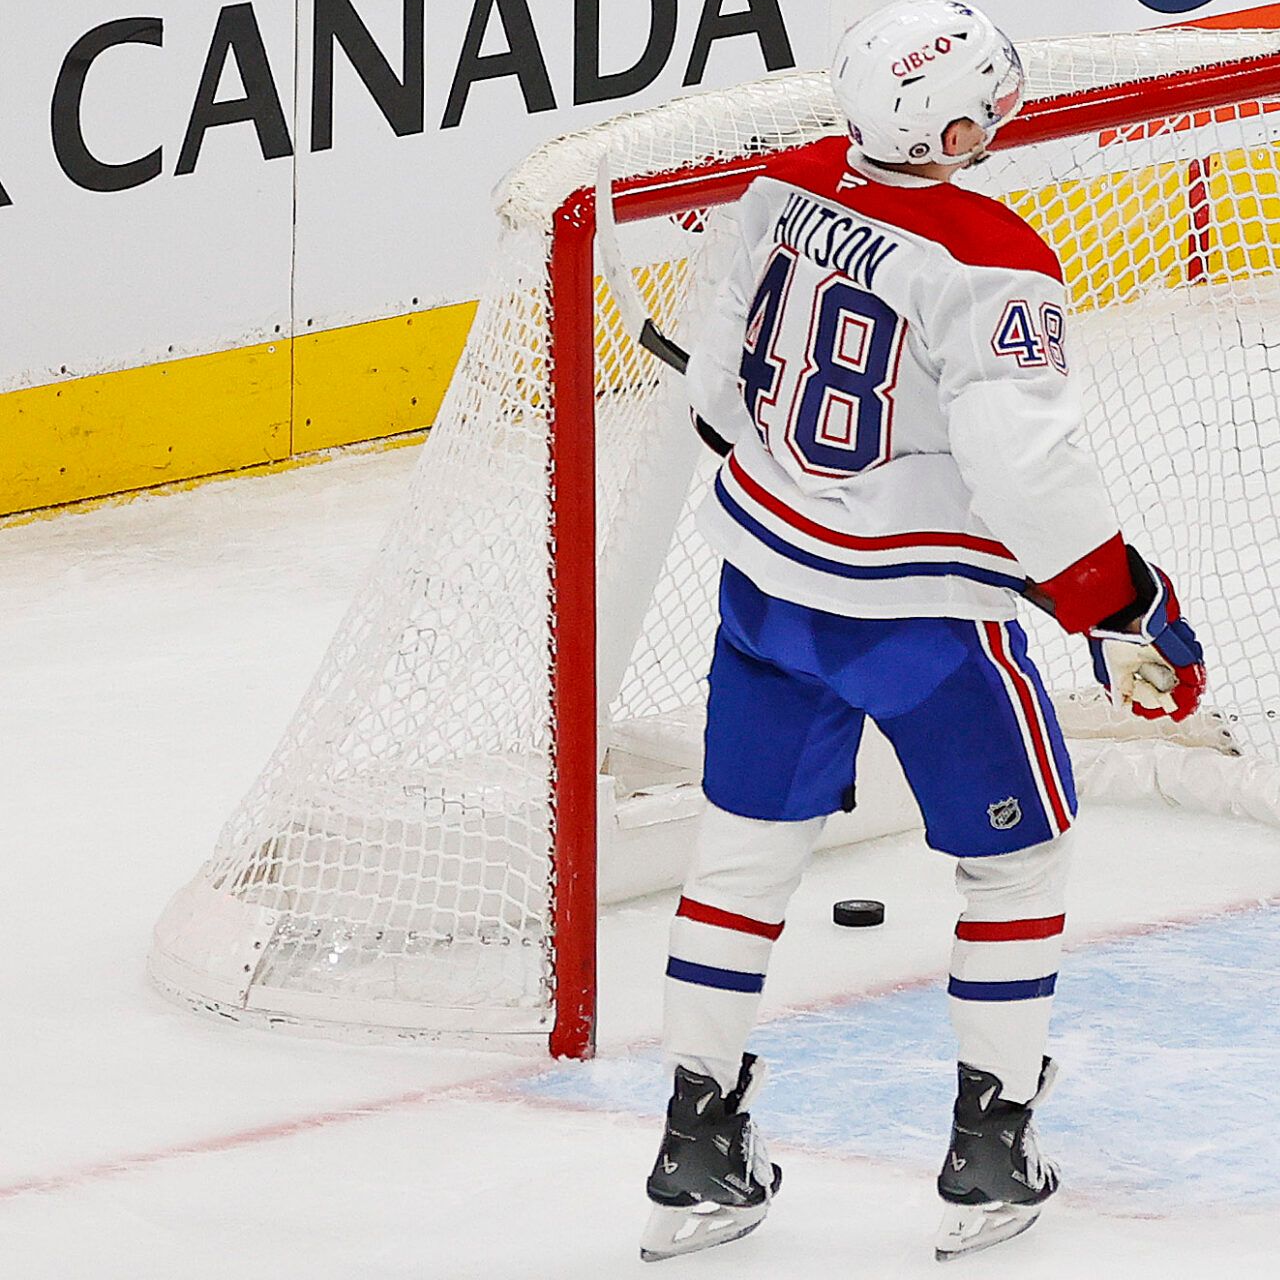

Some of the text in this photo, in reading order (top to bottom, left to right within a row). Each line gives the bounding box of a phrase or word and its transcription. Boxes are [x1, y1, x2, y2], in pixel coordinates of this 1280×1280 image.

[891, 45, 936, 77] CIBC
[775, 192, 899, 291] HUTSON
[737, 244, 910, 478] 48
[991, 299, 1069, 377] 48
